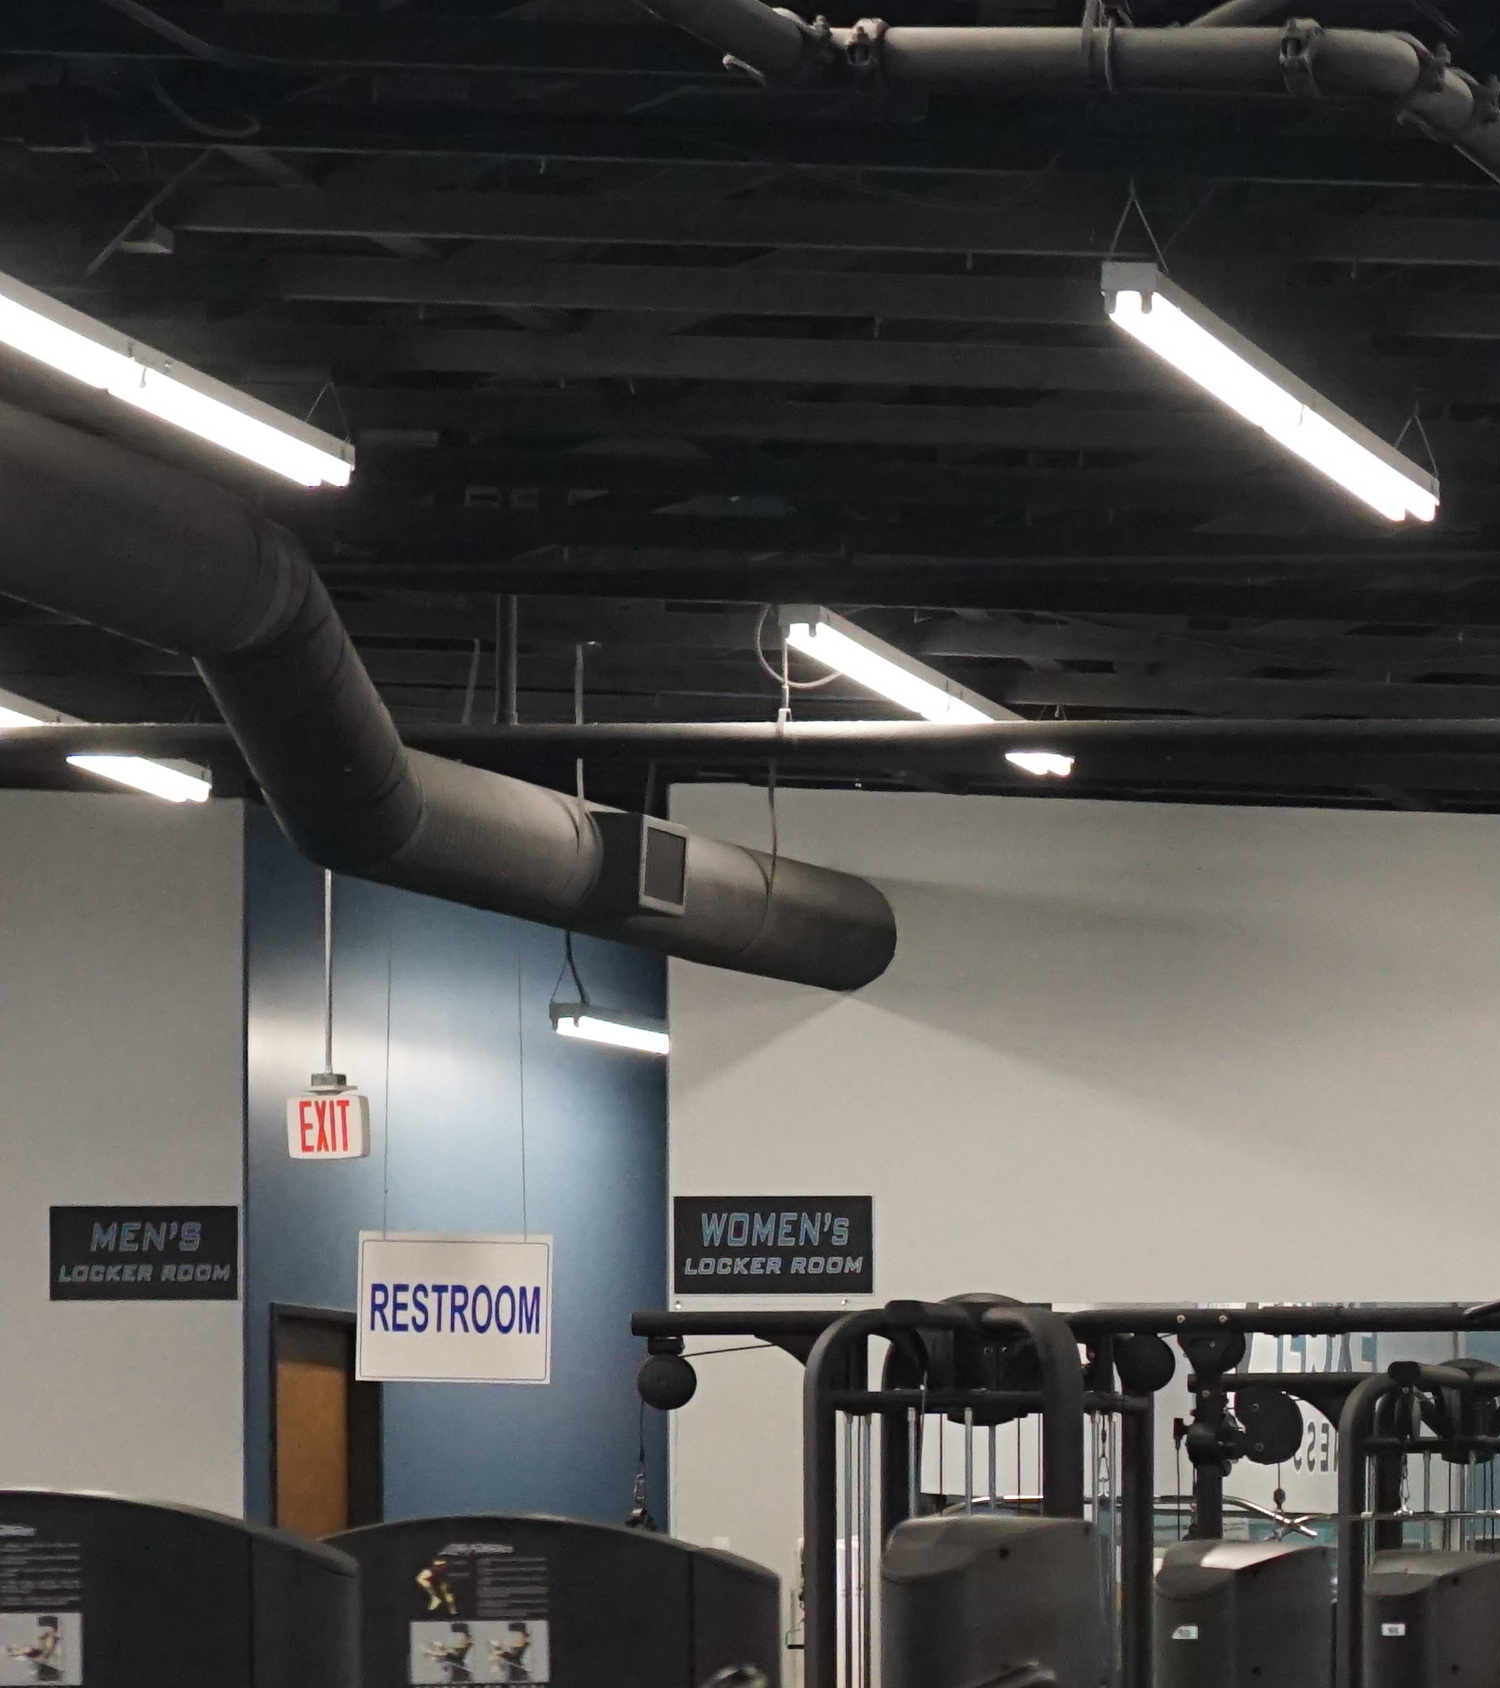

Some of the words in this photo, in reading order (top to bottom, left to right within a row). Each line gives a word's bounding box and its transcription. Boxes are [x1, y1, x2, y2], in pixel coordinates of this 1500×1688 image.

[299, 1099, 350, 1153] EXIT
[90, 1221, 202, 1252] MEN'S
[57, 1264, 154, 1282] LOCKER
[160, 1263, 231, 1282] ROOM
[684, 1257, 782, 1275] LOCKER
[790, 1256, 863, 1274] ROOM
[370, 1283, 541, 1335] RESTROOM
